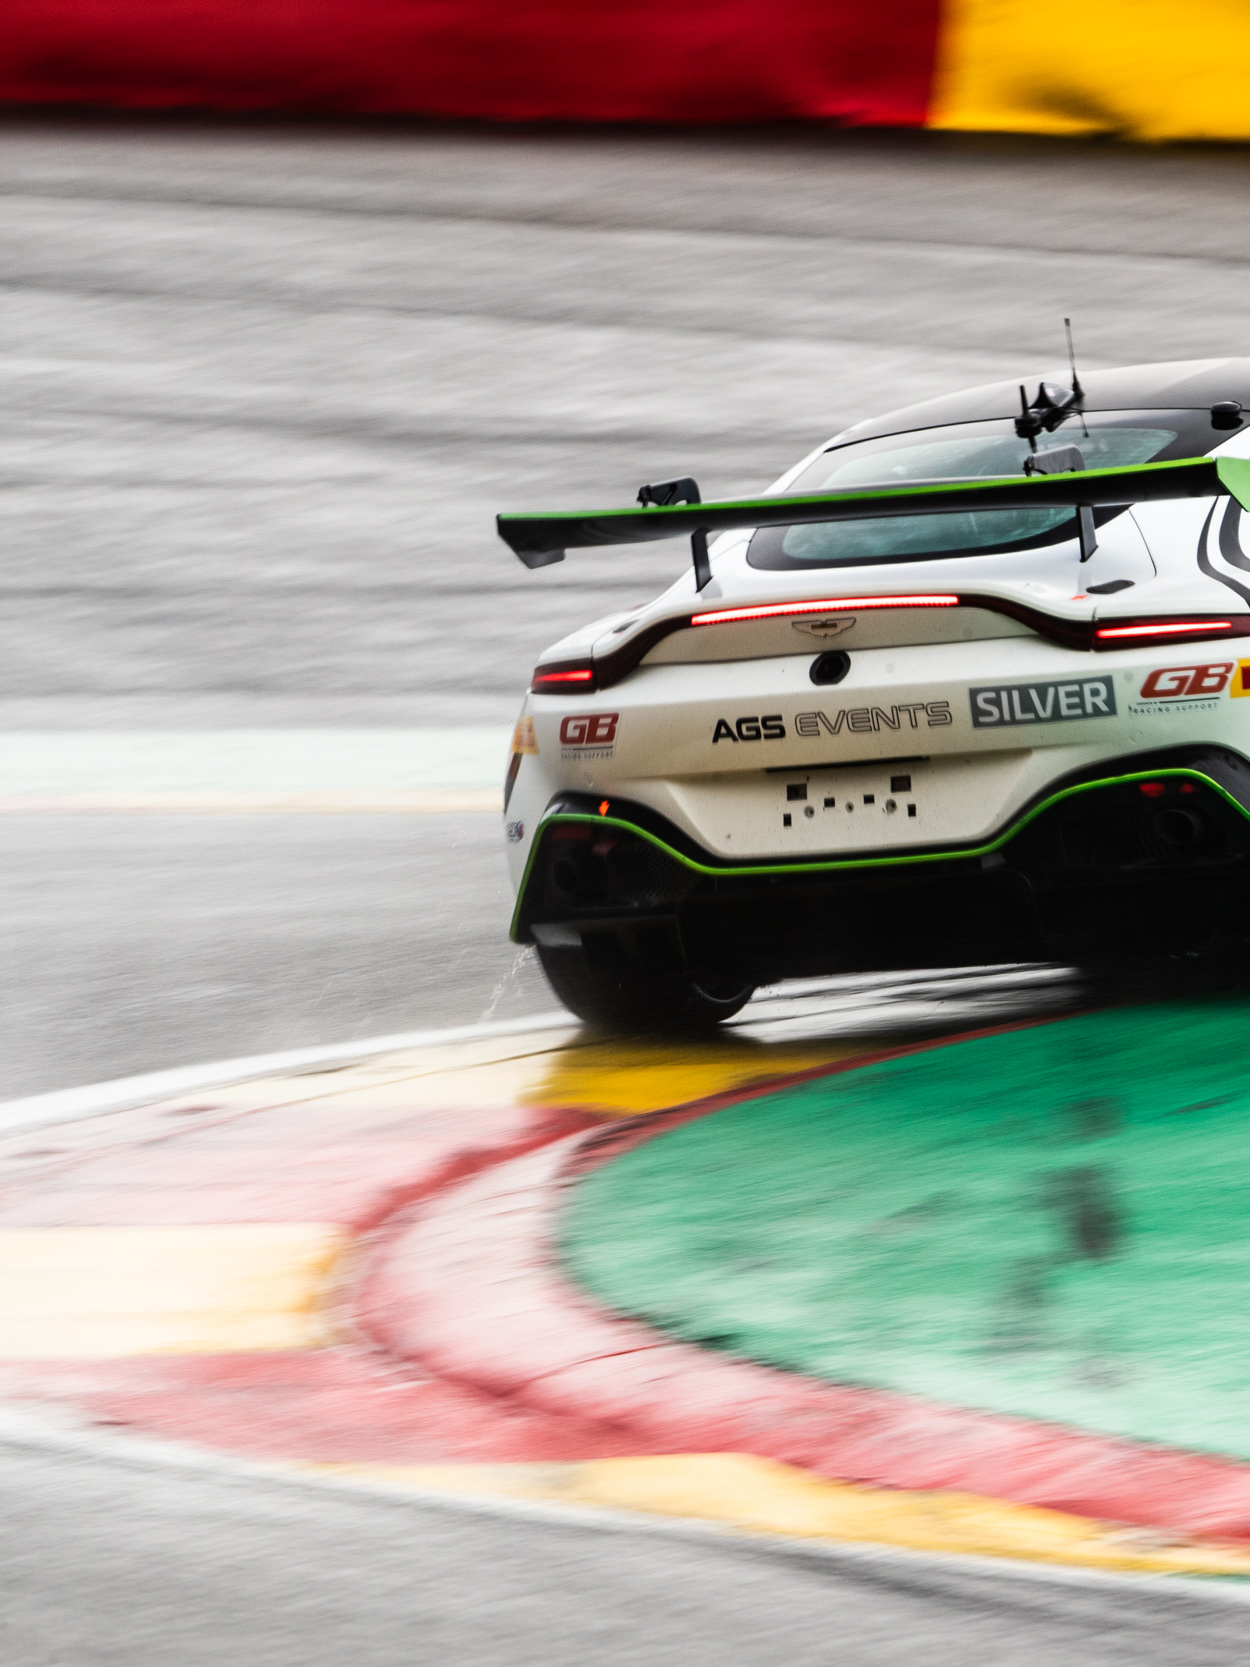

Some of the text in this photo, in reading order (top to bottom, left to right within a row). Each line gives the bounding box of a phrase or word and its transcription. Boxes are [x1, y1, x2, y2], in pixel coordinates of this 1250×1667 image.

[1140, 662, 1235, 698] GB
[976, 681, 1109, 723] SILVER
[1133, 702, 1219, 714] RACING SUPPORT
[559, 712, 620, 745] GB
[712, 701, 953, 744] AGS EVENTS
